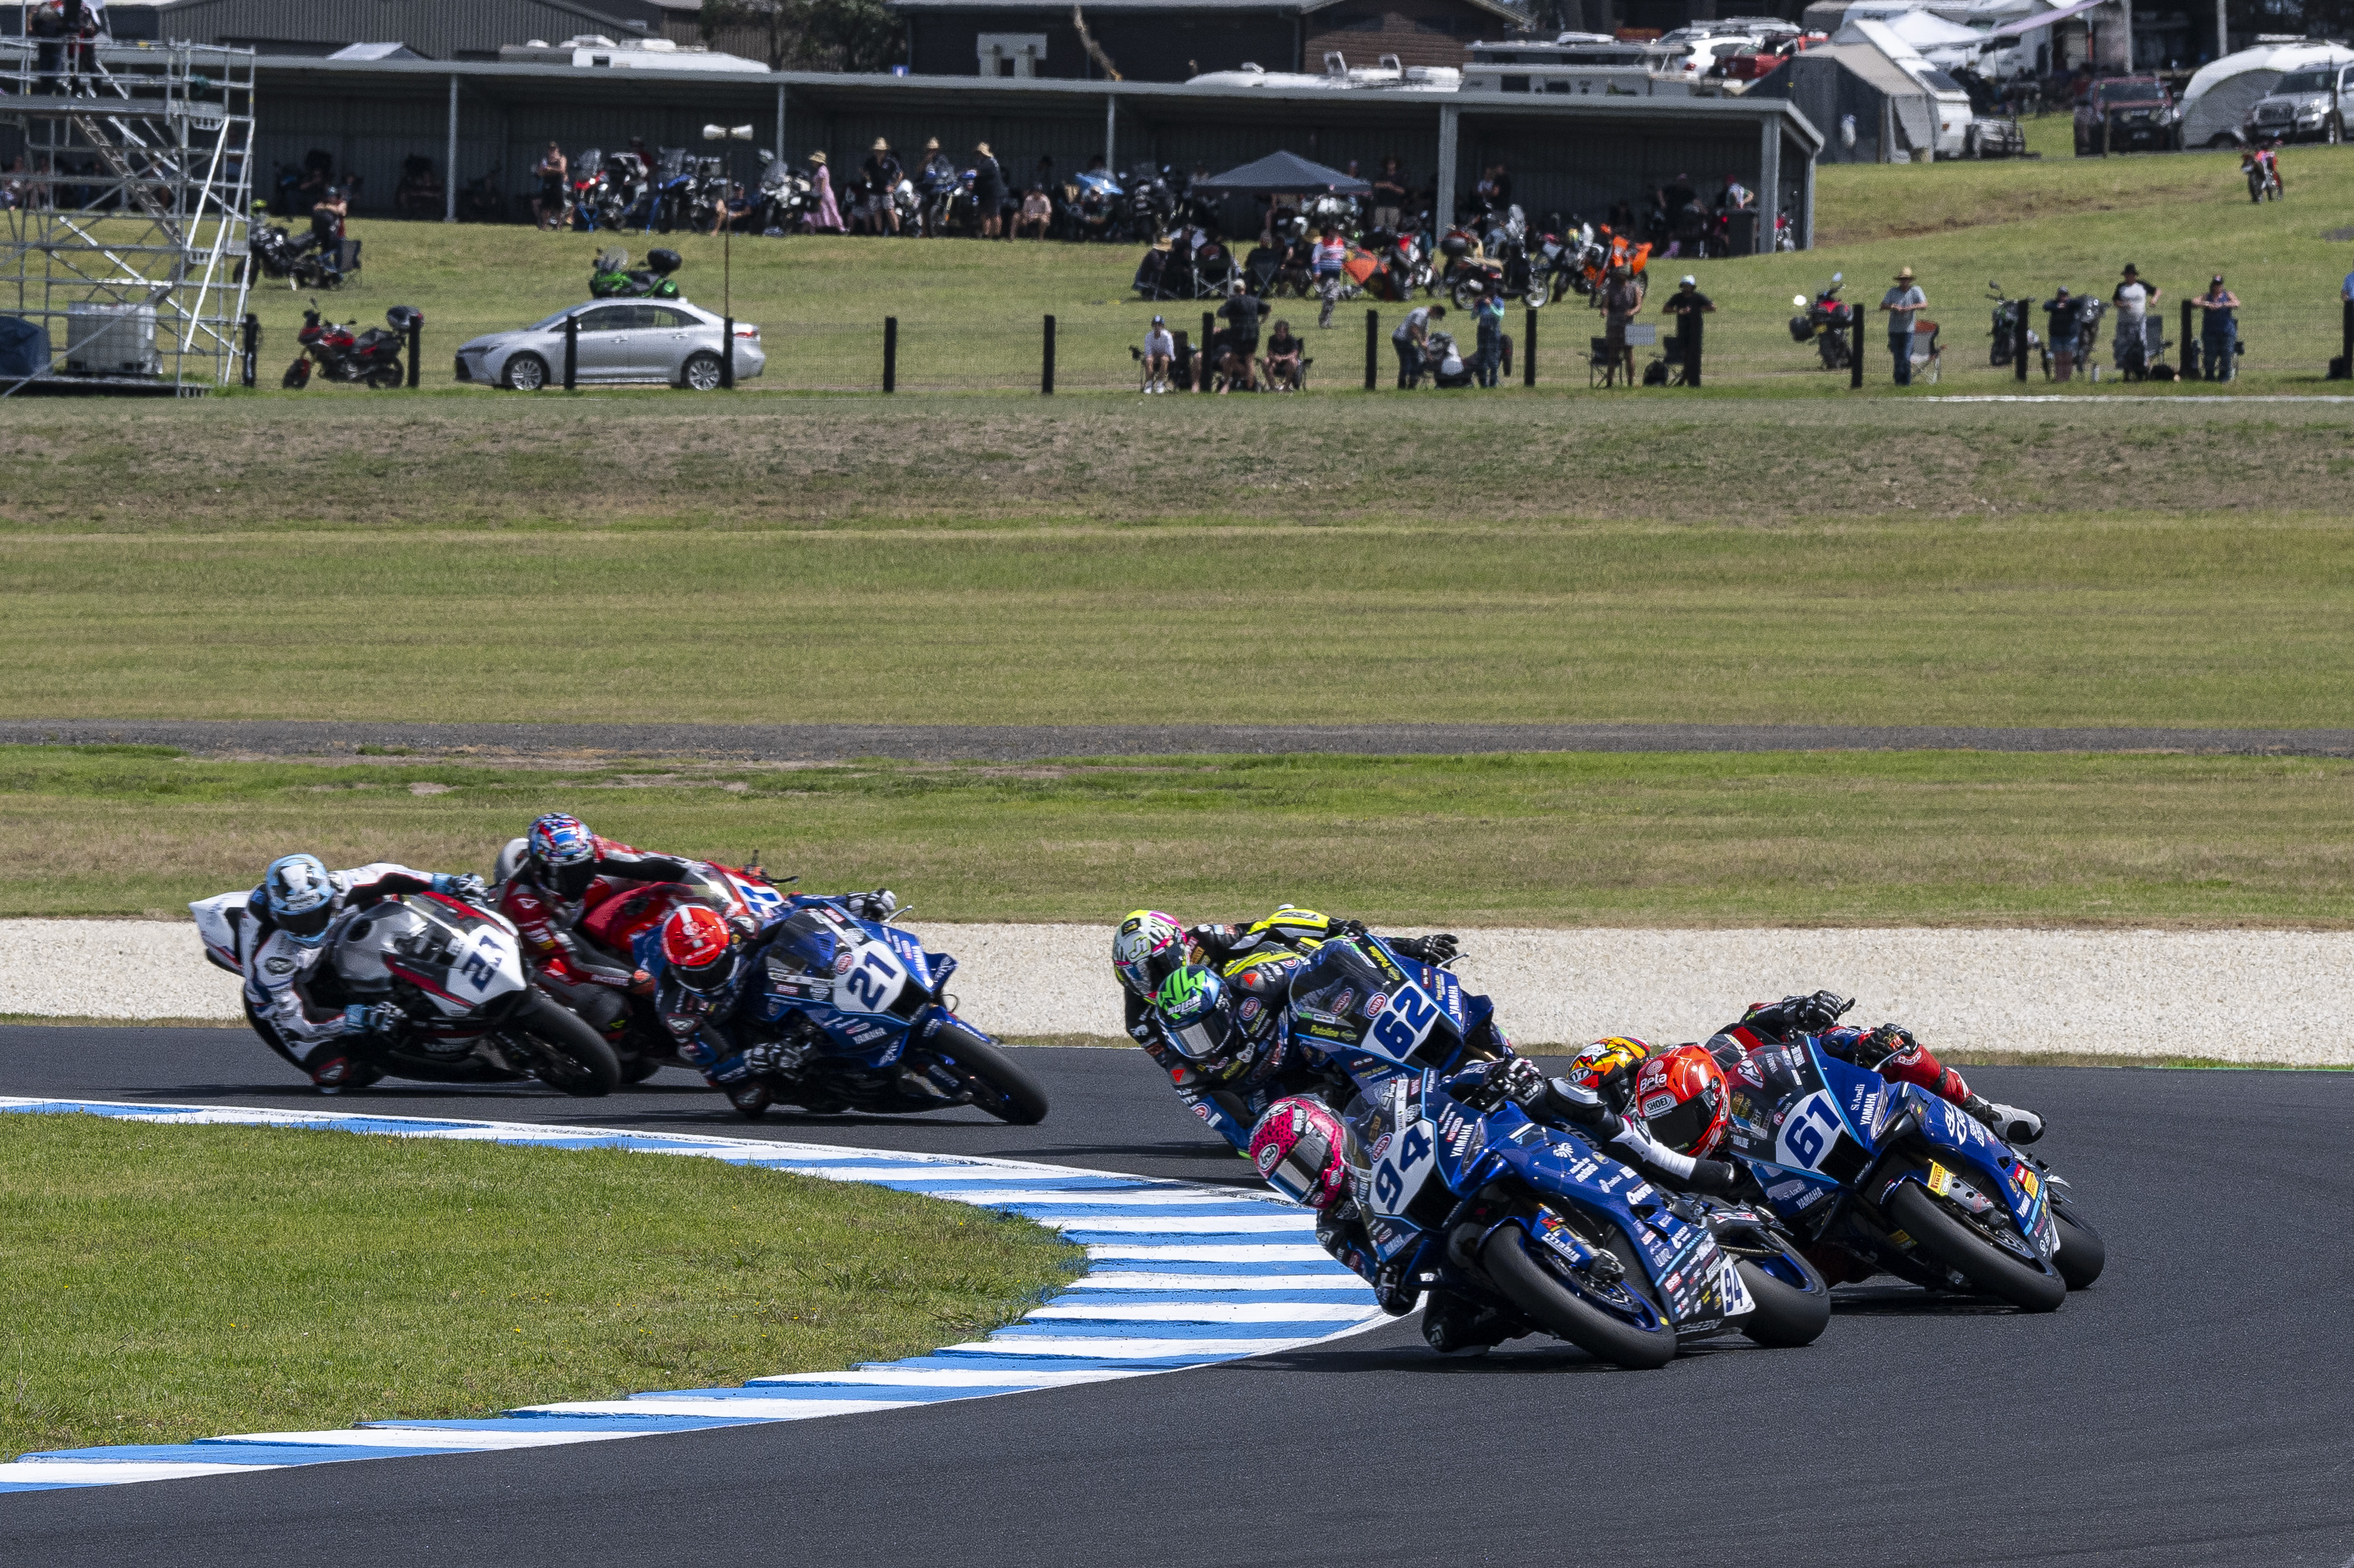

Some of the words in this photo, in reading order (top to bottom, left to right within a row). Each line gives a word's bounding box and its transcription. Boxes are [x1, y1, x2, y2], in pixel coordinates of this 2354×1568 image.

[848, 951, 898, 1011] 21
[1369, 996, 1384, 1016] PATA
[1448, 986, 1459, 1015] YAMAHA
[1374, 986, 1438, 1059] 62
[1640, 1072, 1667, 1092] Beta
[1647, 1097, 1668, 1113] SHOEI
[1781, 1101, 1793, 1114] tools
[1860, 1093, 1878, 1125] YAMAHA
[1449, 1124, 1475, 1157] YAMAHA
[1785, 1094, 1841, 1170] 61
[1373, 1137, 1389, 1159] PATA
[1376, 1124, 1432, 1214] 94
[1931, 1165, 1942, 1189] PIRELLI
[1796, 1187, 1824, 1210] YAMAHA
[1541, 1232, 1581, 1263] PIRELLI
[1724, 1264, 1743, 1313] 94
